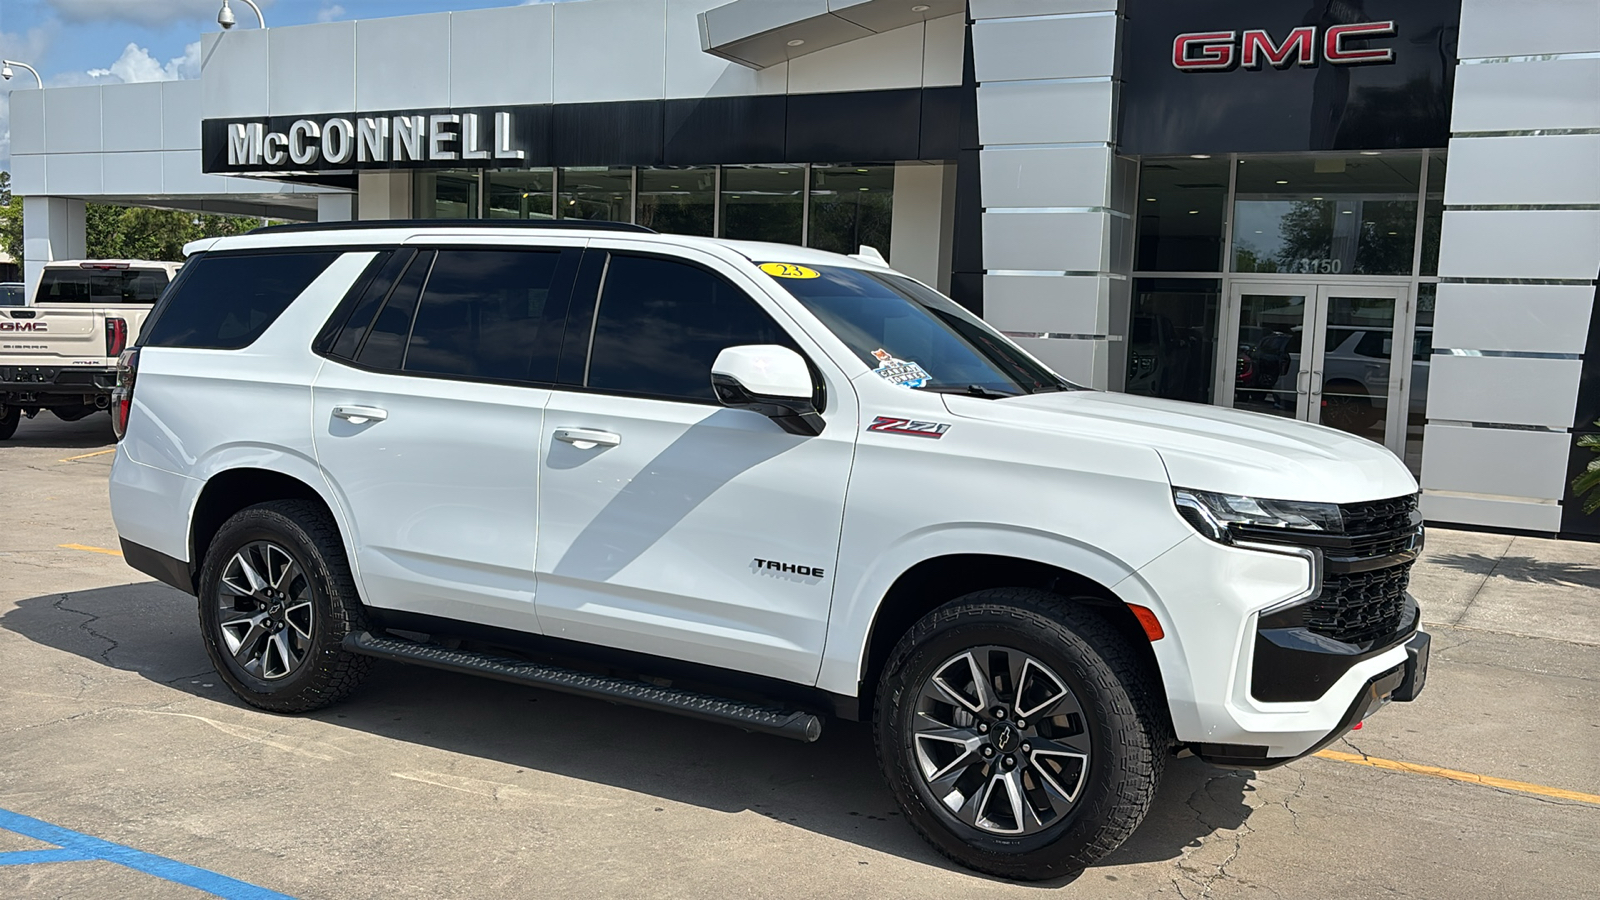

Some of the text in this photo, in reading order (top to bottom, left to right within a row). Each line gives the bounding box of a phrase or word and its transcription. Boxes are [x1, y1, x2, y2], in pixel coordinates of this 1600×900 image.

[1172, 20, 1395, 70] GMC
[227, 111, 525, 166] McCONNELL
[776, 264, 803, 277] 23
[1300, 258, 1341, 273] 3150
[0, 322, 48, 332] GMC
[866, 416, 952, 439] Z71
[754, 558, 824, 578] TAHOE
